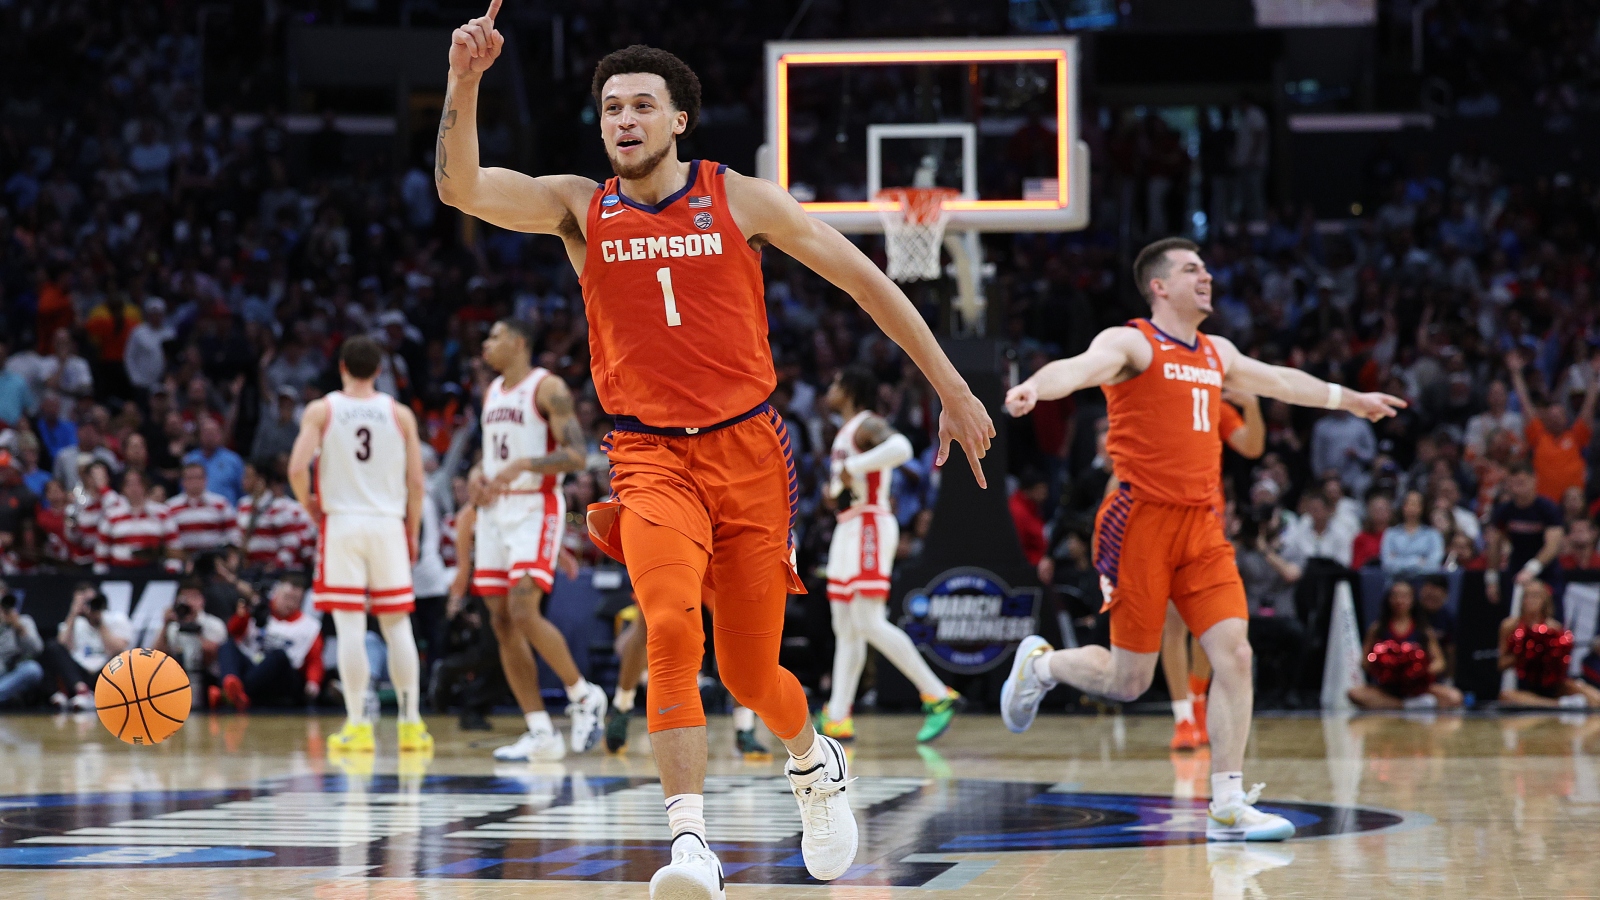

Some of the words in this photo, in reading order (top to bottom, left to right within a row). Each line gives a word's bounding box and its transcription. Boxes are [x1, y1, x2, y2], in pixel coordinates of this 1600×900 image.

[601, 232, 723, 263] CLEMSON
[656, 267, 682, 327] 1
[1191, 387, 1211, 433] 11
[355, 428, 372, 461] 3
[492, 432, 509, 460] 16
